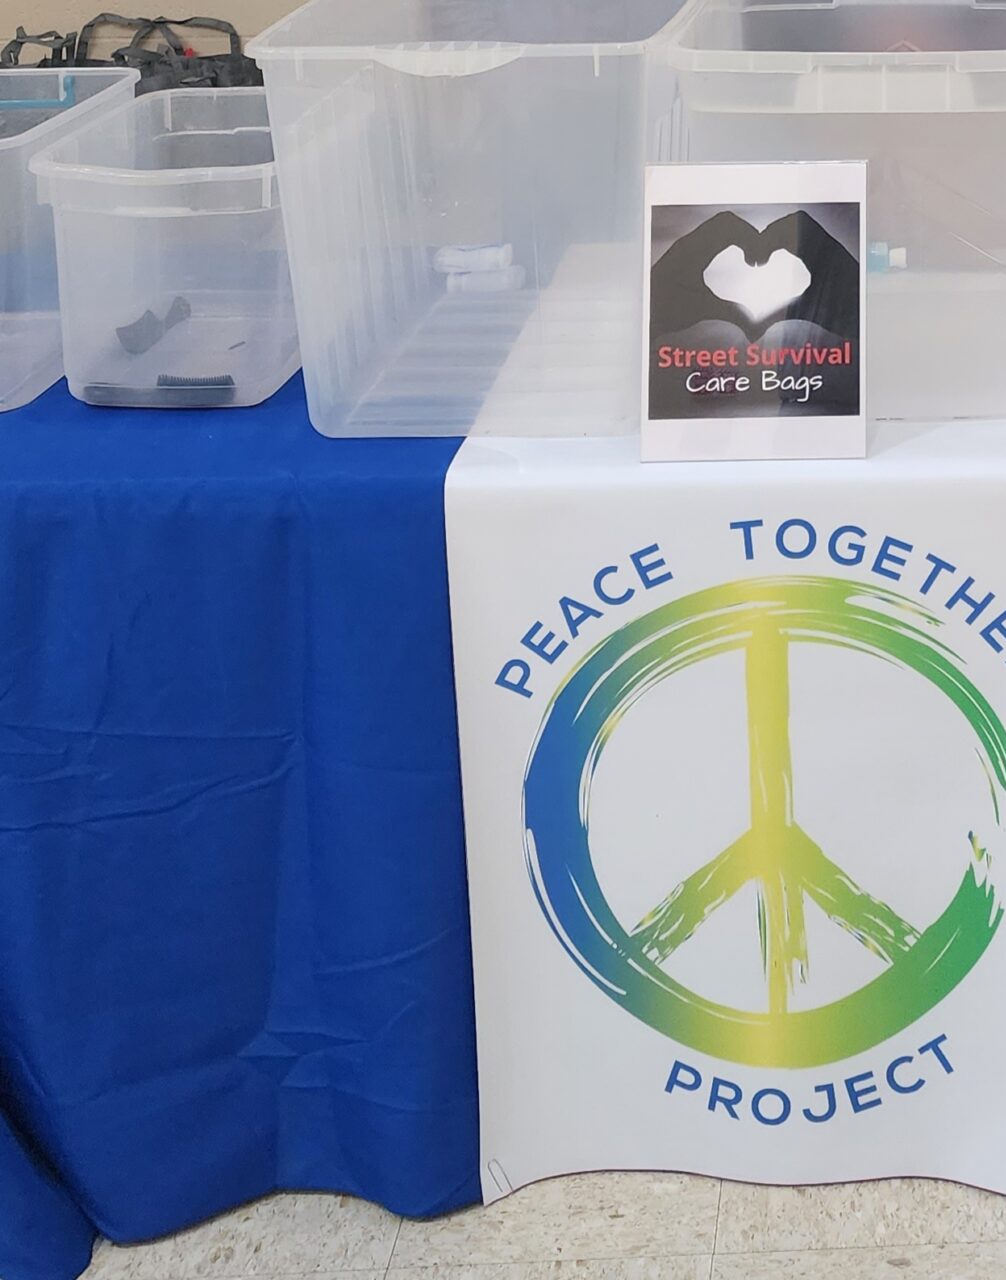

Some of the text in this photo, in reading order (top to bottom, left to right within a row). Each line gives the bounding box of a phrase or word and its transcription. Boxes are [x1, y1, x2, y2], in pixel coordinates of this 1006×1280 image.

[658, 342, 852, 368] Street Survival
[685, 370, 823, 402] Care Bags
[494, 544, 674, 700] PEACE
[664, 1034, 955, 1125] PROJECT
